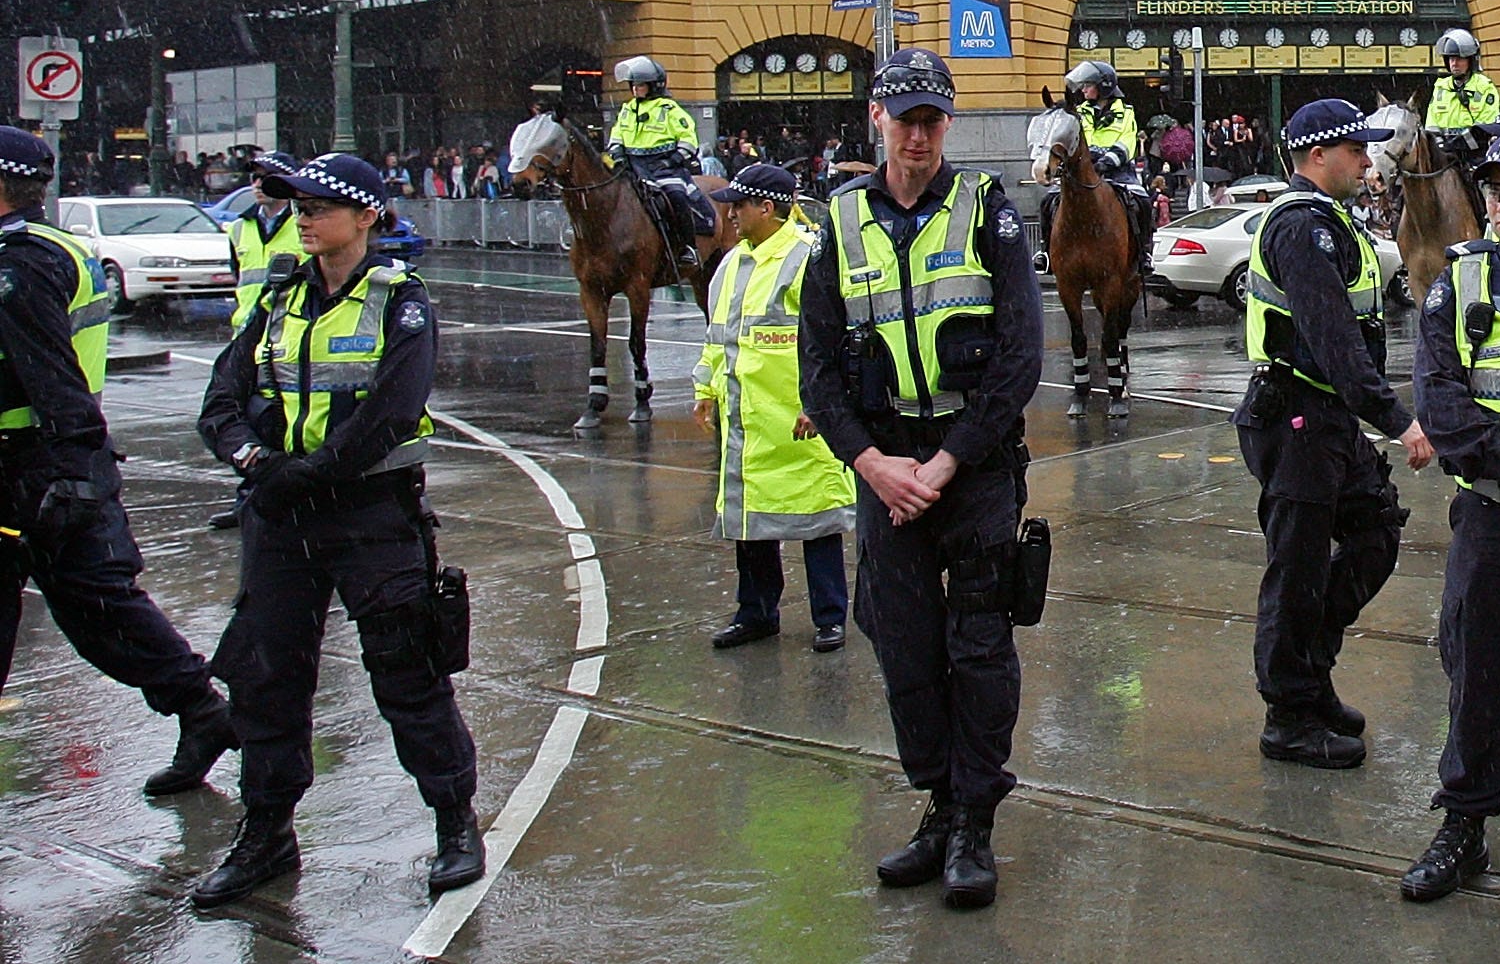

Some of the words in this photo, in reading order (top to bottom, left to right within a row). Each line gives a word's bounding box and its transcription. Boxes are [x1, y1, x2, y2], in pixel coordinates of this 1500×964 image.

[1136, 0, 1225, 15] FLINDERS
[1248, 0, 1313, 15] STREET
[1335, 0, 1413, 14] STATION
[960, 38, 995, 48] METRO
[927, 253, 963, 268] Police
[331, 339, 374, 350] Police
